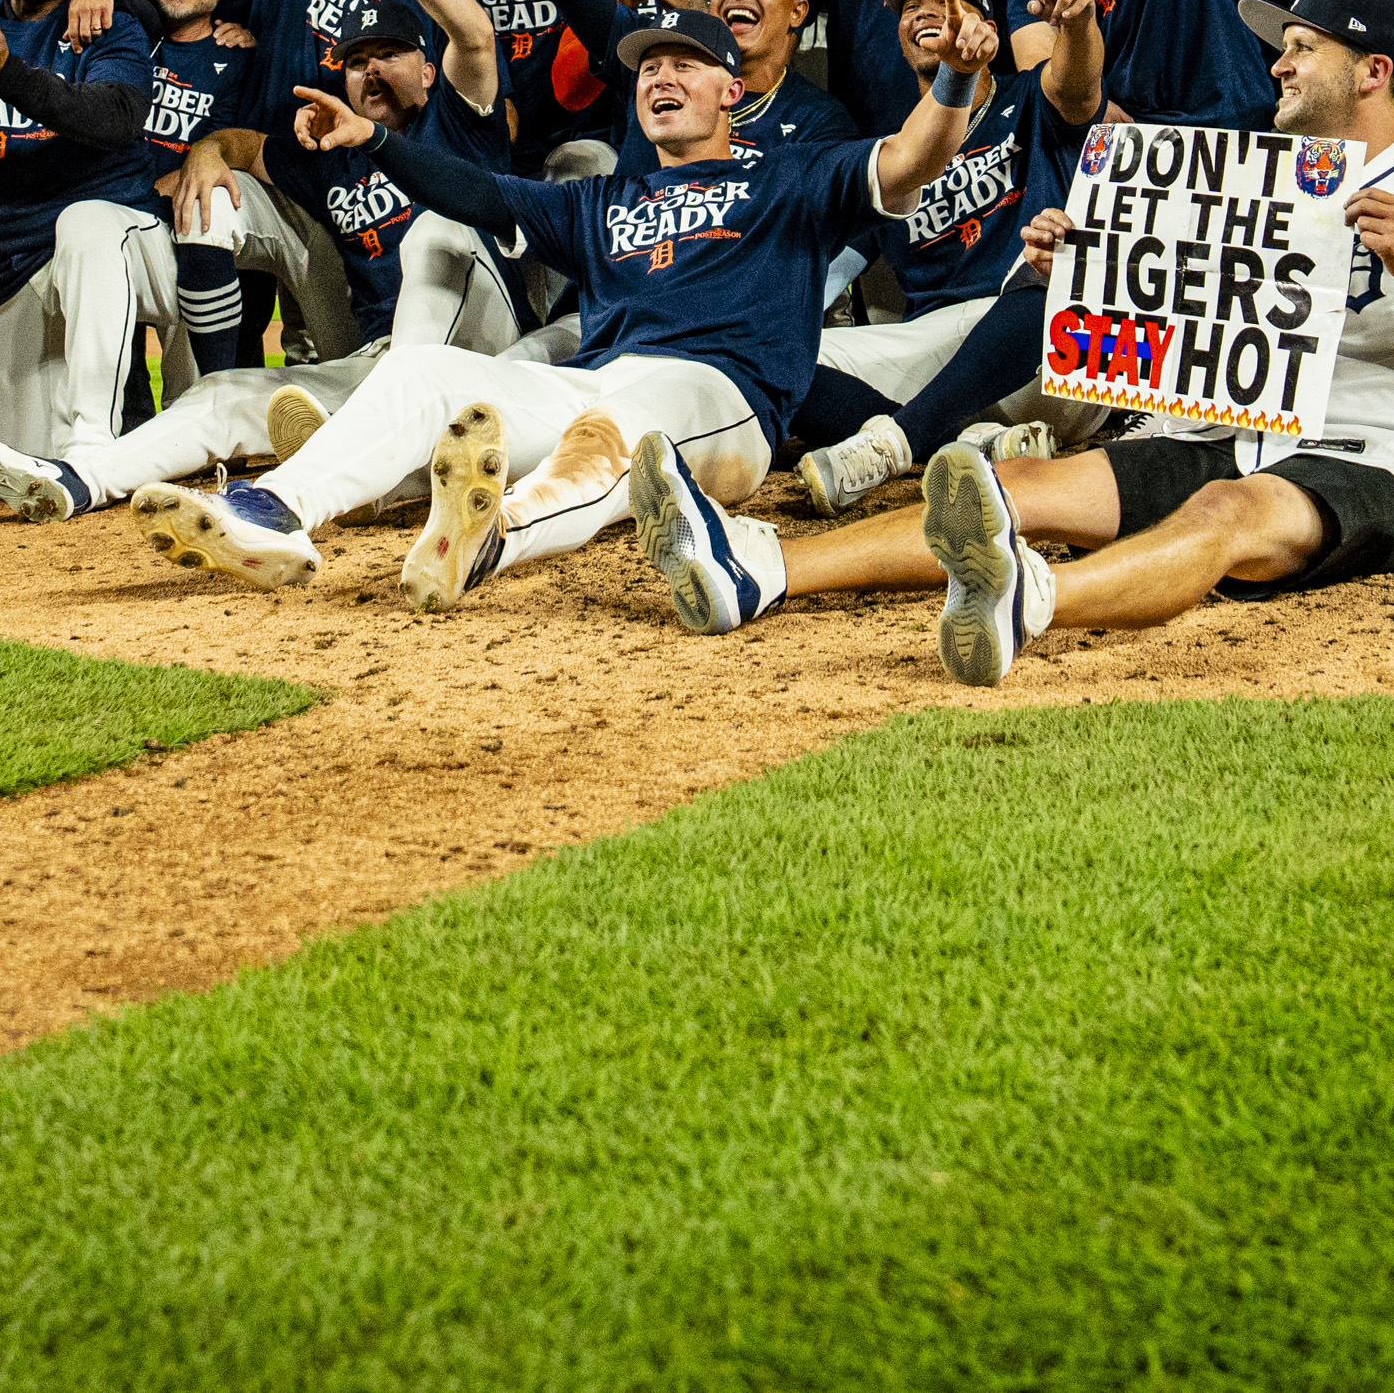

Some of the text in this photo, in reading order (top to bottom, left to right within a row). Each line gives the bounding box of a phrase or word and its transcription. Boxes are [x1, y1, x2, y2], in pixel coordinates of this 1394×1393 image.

[918, 132, 1023, 207] CTOBER
[1109, 126, 1293, 198] DON'T
[607, 182, 751, 229] OCTOBER
[610, 201, 734, 255] READY
[907, 159, 1014, 243] READY
[1084, 184, 1294, 250] LET THE
[1064, 229, 1316, 330] TIGERS
[1047, 310, 1319, 412] STAY HOT
